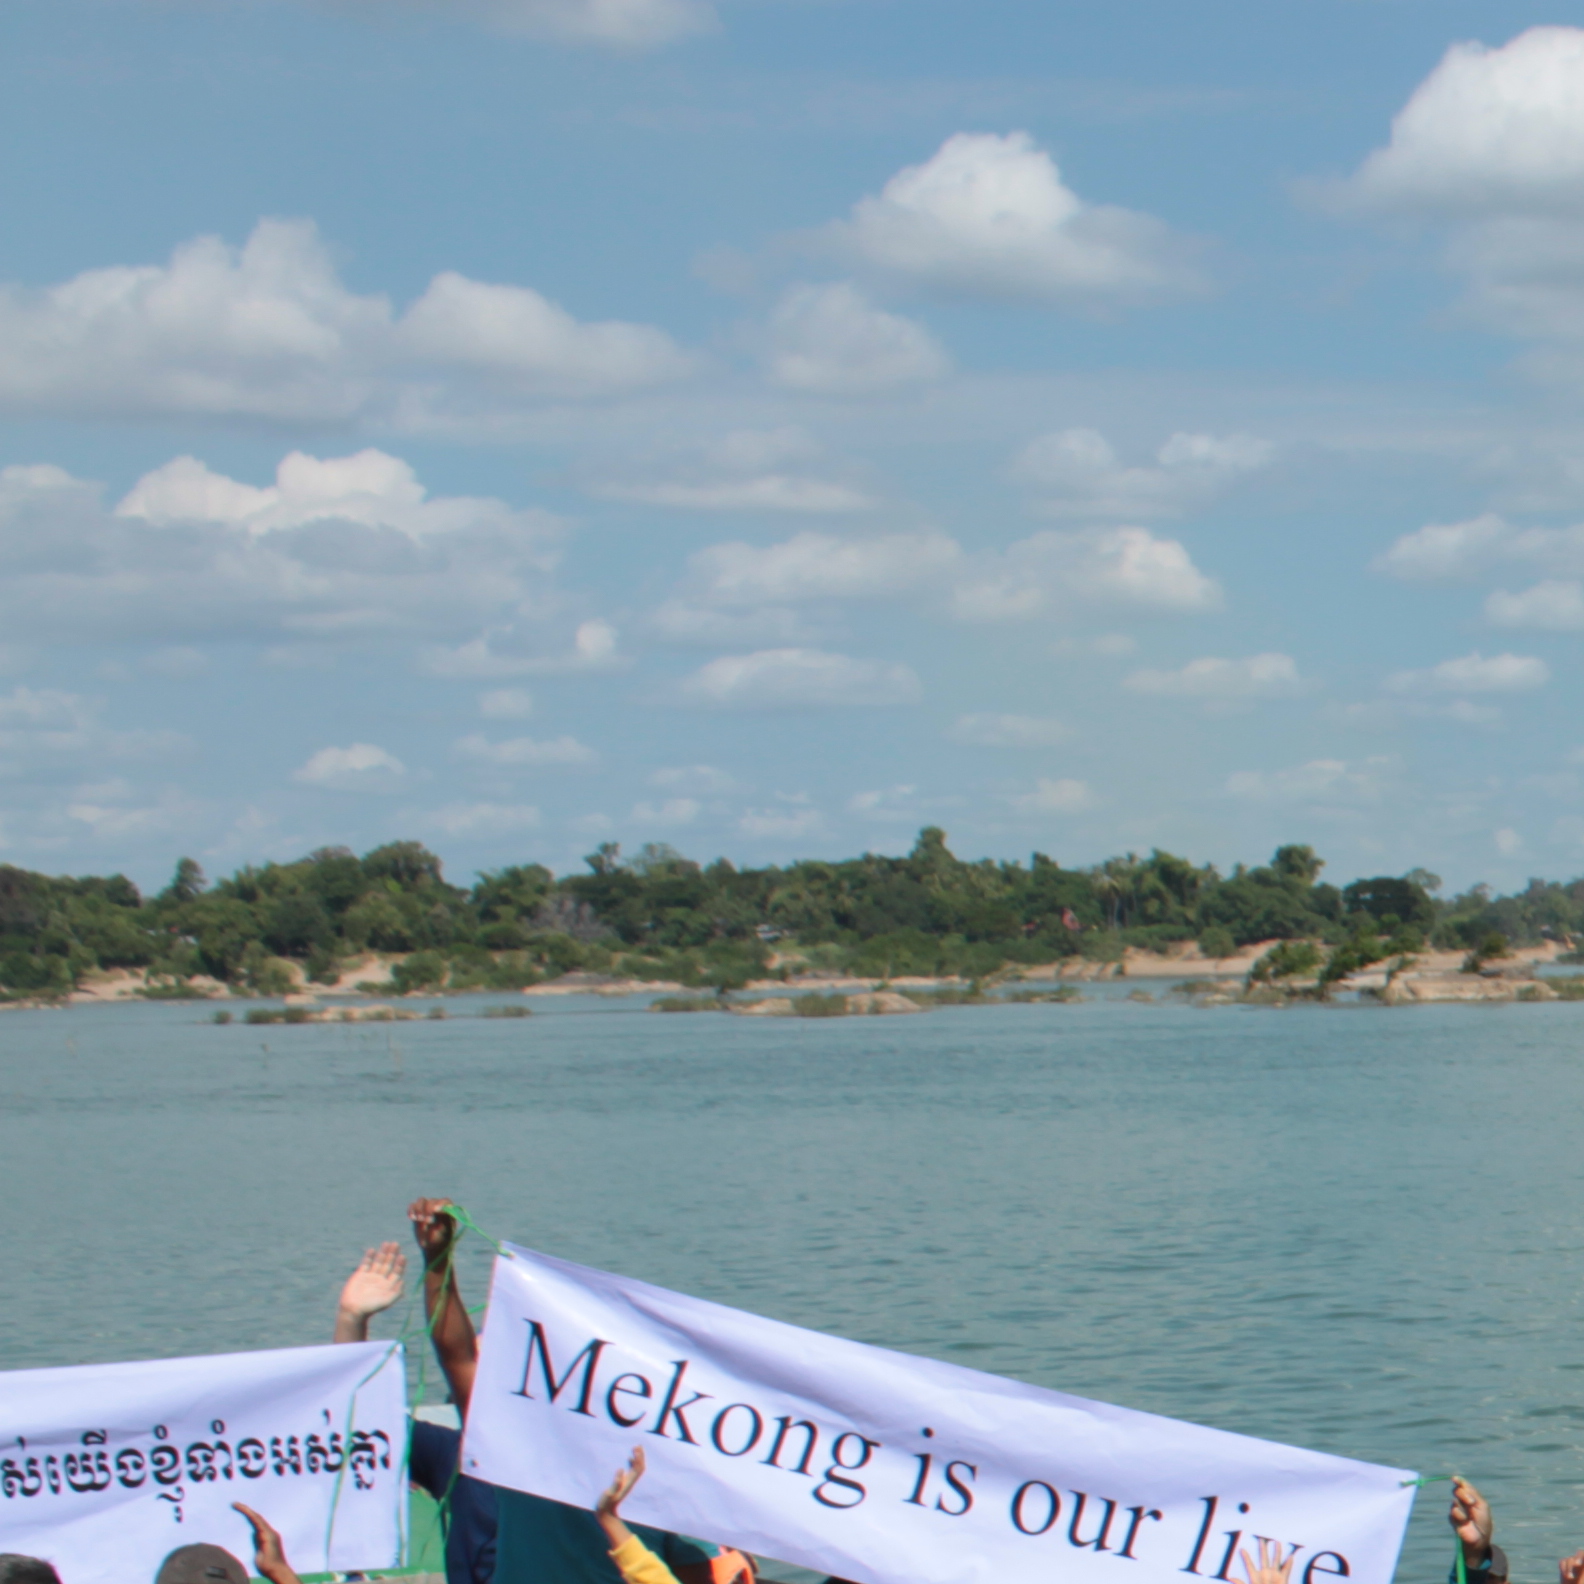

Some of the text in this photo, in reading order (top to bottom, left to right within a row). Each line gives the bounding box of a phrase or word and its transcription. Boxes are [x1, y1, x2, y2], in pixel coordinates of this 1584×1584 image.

[511, 1318, 881, 1509] Mekong
[903, 1427, 977, 1516] is
[1010, 1478, 1162, 1560] our
